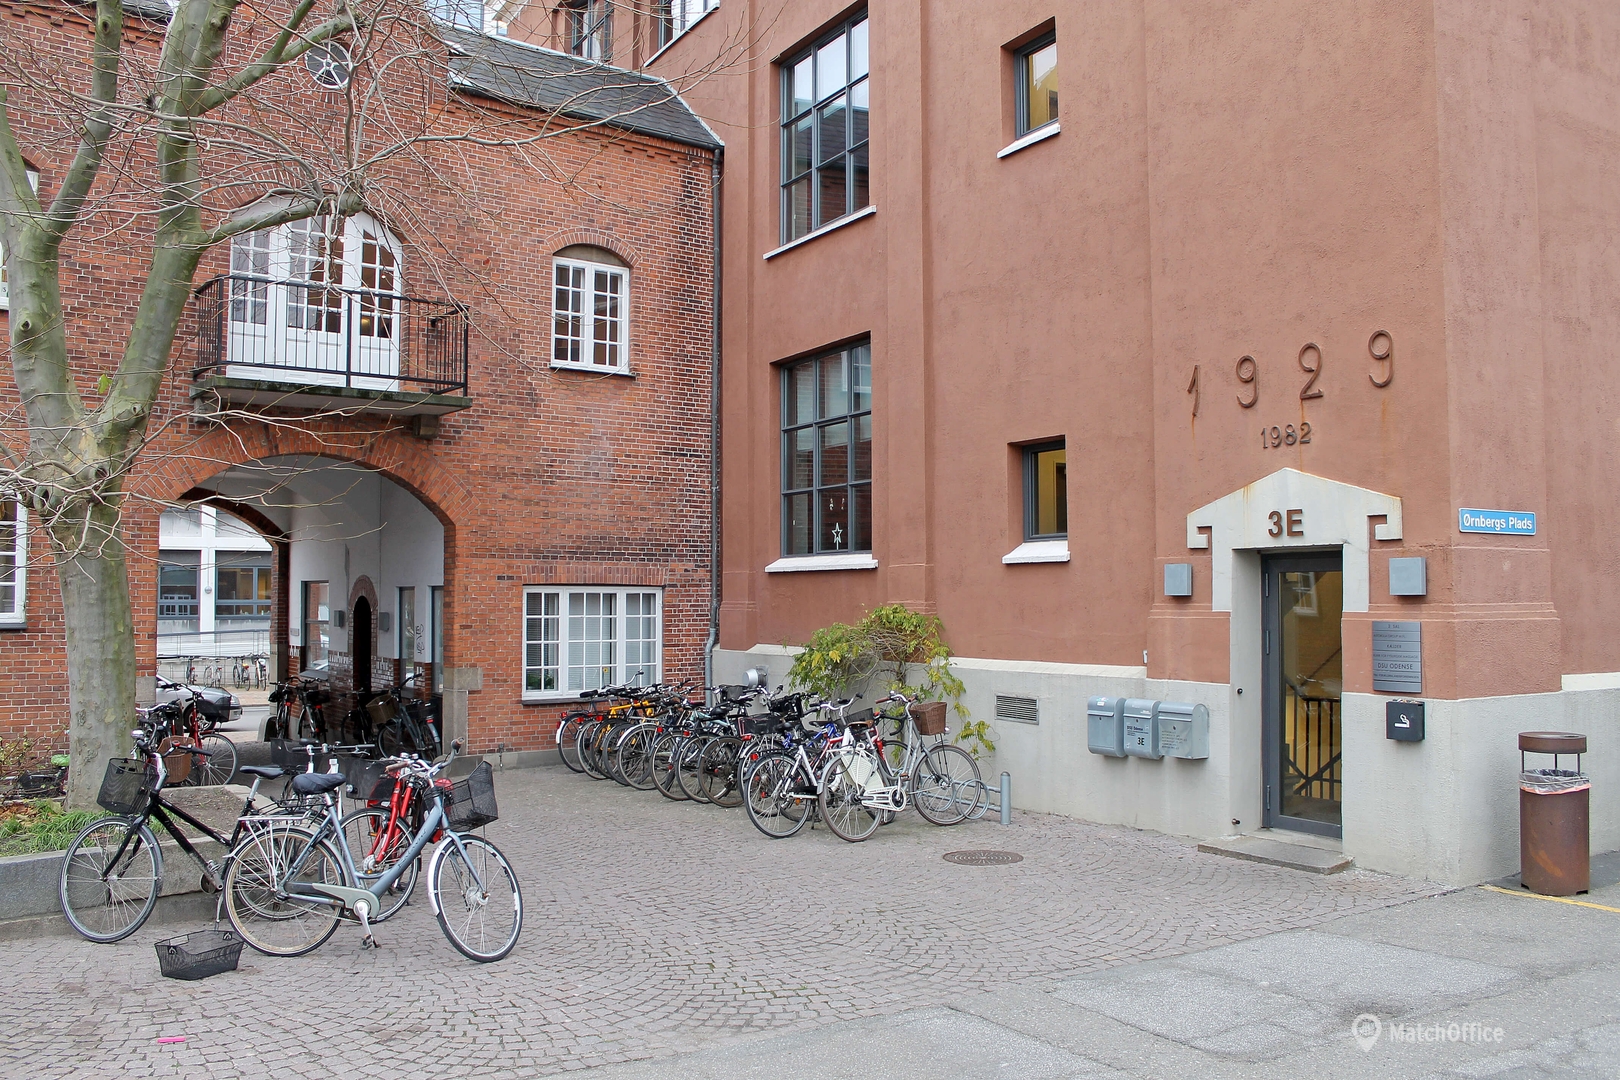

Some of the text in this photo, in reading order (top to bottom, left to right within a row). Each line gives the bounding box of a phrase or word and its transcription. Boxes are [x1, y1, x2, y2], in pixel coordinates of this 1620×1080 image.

[1187, 329, 1396, 418] 1929
[1260, 421, 1312, 450] 1982
[1267, 508, 1304, 538] 3E
[1463, 513, 1533, 531] Ørnbergs Plads
[1137, 737, 1145, 746] 3E
